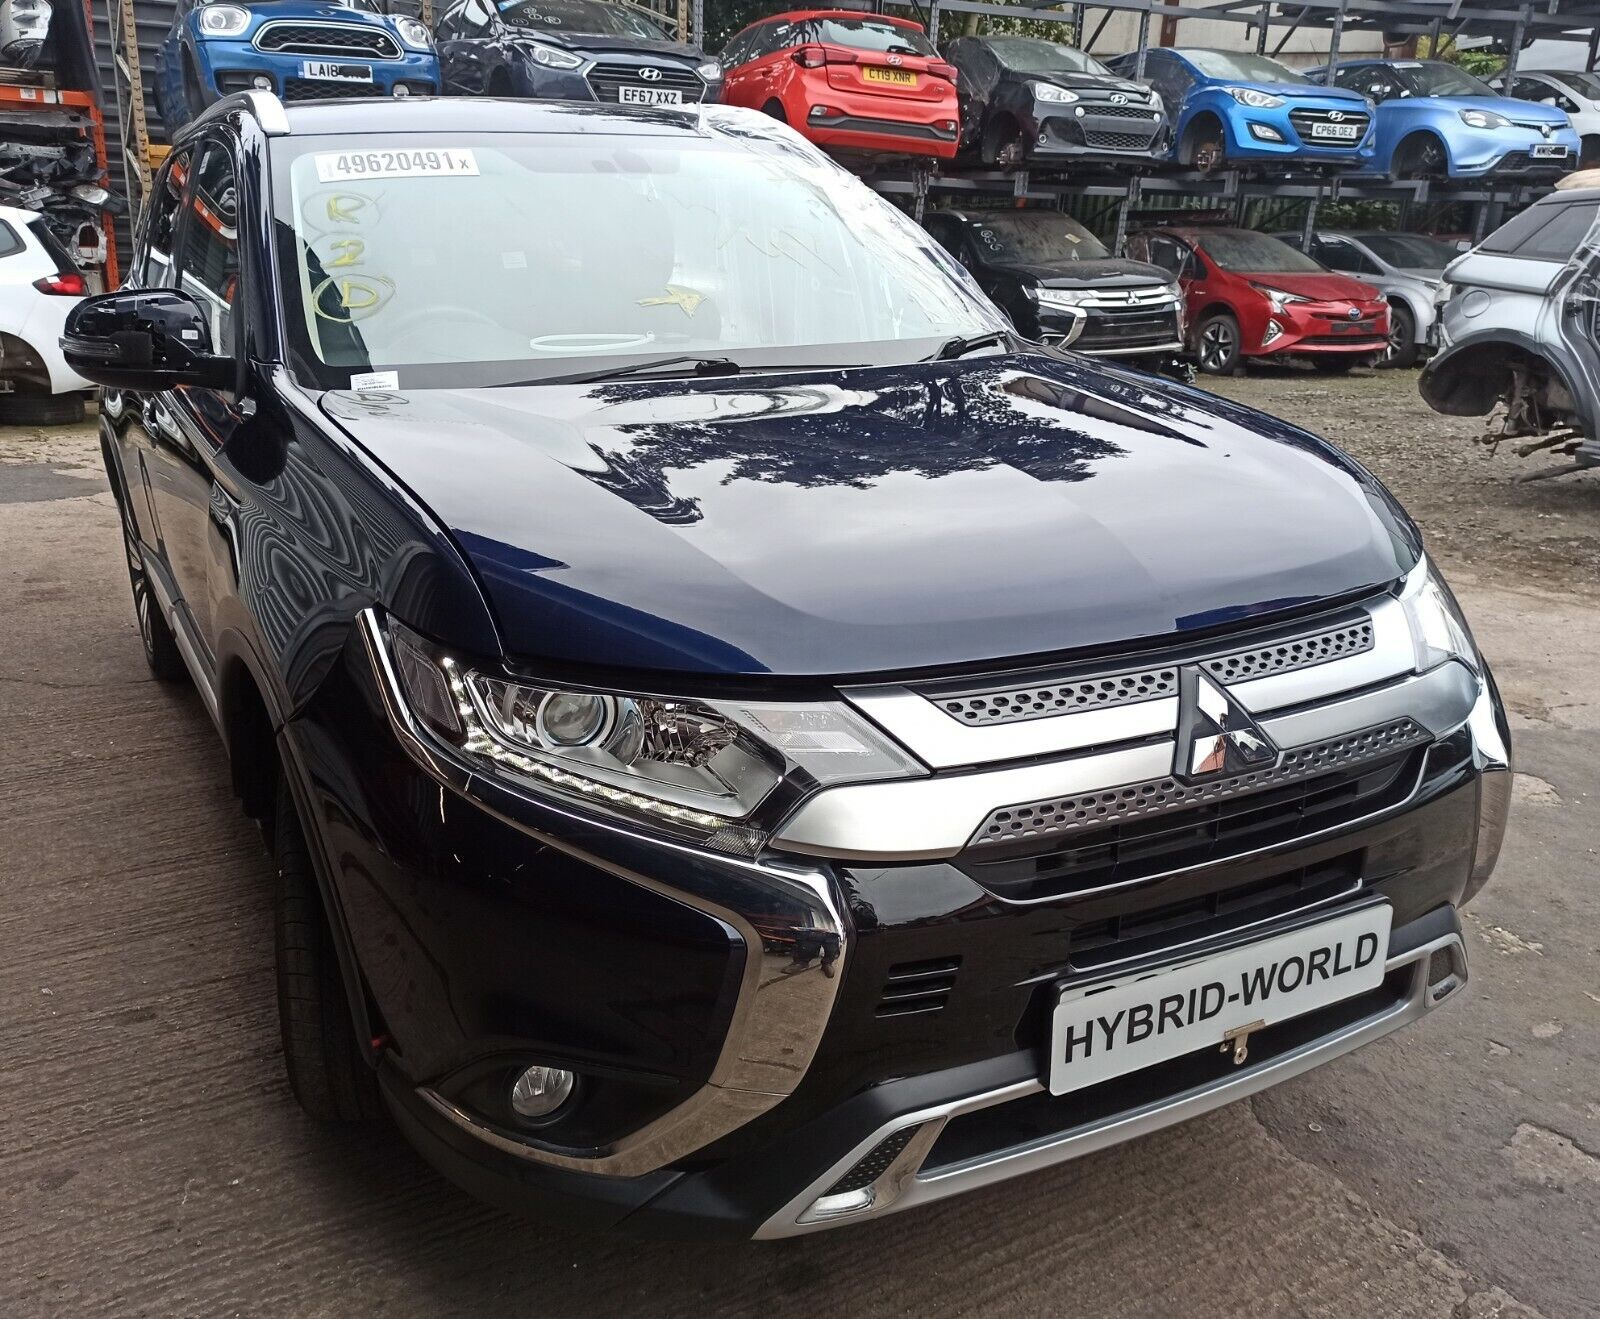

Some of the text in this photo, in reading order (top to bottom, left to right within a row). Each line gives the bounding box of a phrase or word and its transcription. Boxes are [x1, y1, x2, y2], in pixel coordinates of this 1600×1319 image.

[869, 68, 911, 83] CT19 XNR
[624, 90, 677, 105] EF67 XXZ
[1315, 125, 1337, 136] CP66
[337, 152, 454, 174] 49620491
[326, 194, 366, 225] R
[341, 281, 378, 308] D
[1064, 931, 1379, 1064] HYBRID-WORLD
